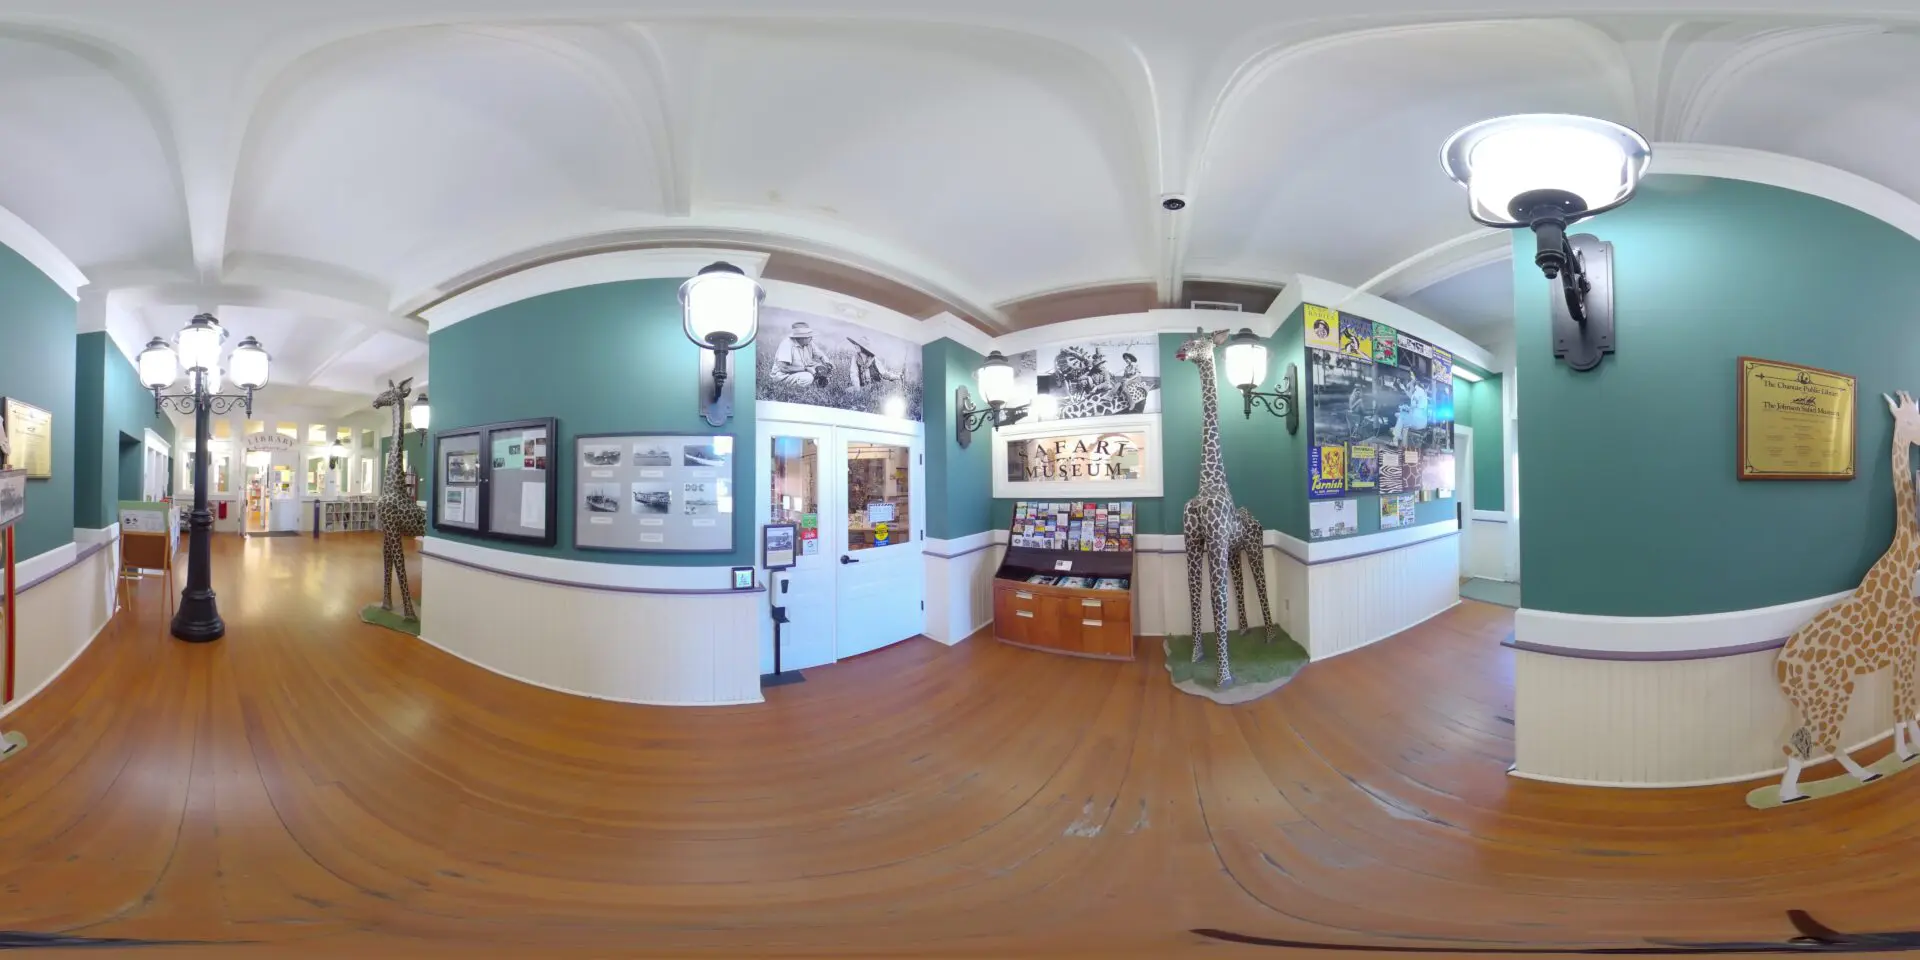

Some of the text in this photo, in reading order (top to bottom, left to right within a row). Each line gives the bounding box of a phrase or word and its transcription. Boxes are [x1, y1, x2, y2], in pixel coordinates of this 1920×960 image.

[1764, 380, 1775, 388] The
[1803, 386, 1820, 394] Public
[1776, 403, 1800, 411] Johnson
[248, 435, 294, 447] LIBRARY
[1018, 439, 1128, 459] SAFARI
[1025, 462, 1122, 479] MUSEUM
[1312, 474, 1343, 491] Tarnish
